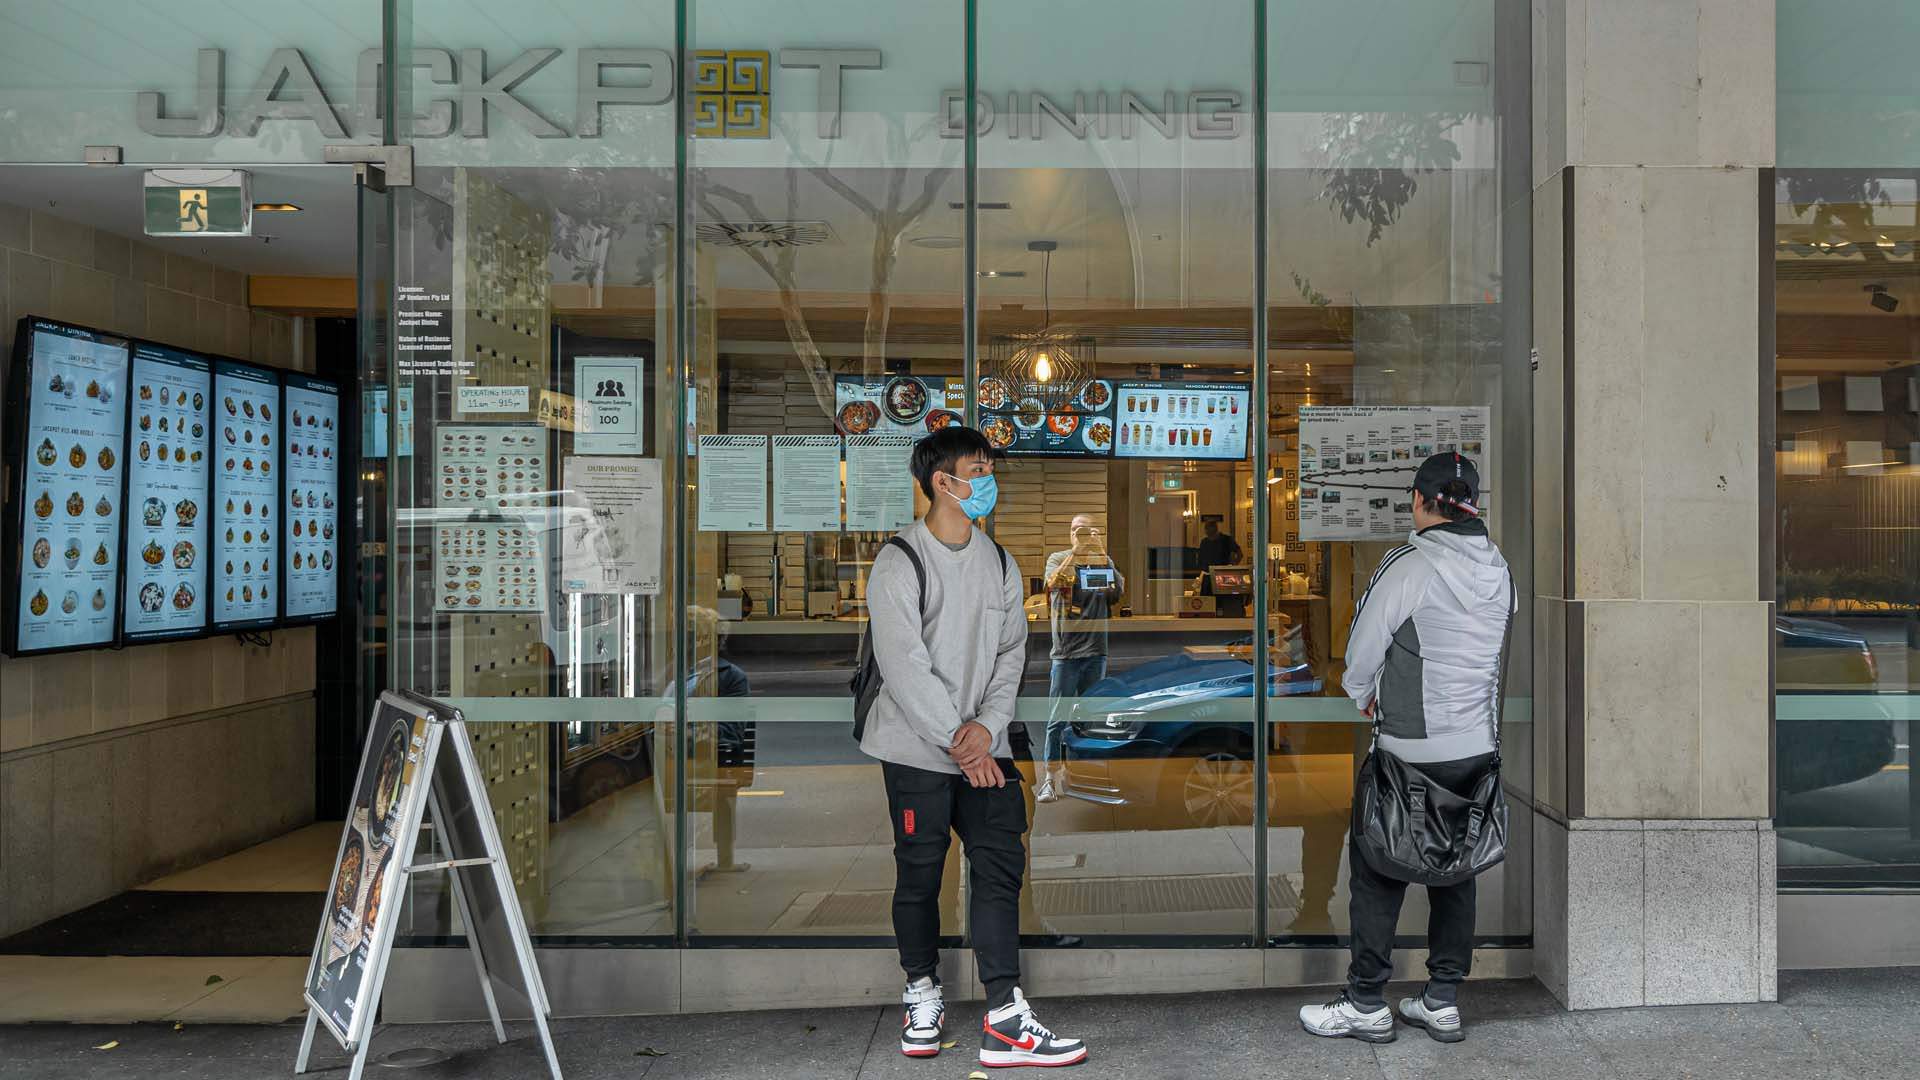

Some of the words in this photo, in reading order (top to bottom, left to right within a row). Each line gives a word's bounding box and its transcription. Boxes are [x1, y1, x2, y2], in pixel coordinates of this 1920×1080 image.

[939, 88, 1241, 140] DINING
[431, 294, 440, 302] Pty
[437, 360, 457, 368] Trading
[613, 399, 633, 407] Seating
[599, 415, 619, 425] 100
[587, 465, 605, 473] OUR
[606, 465, 639, 473] PROMISE
